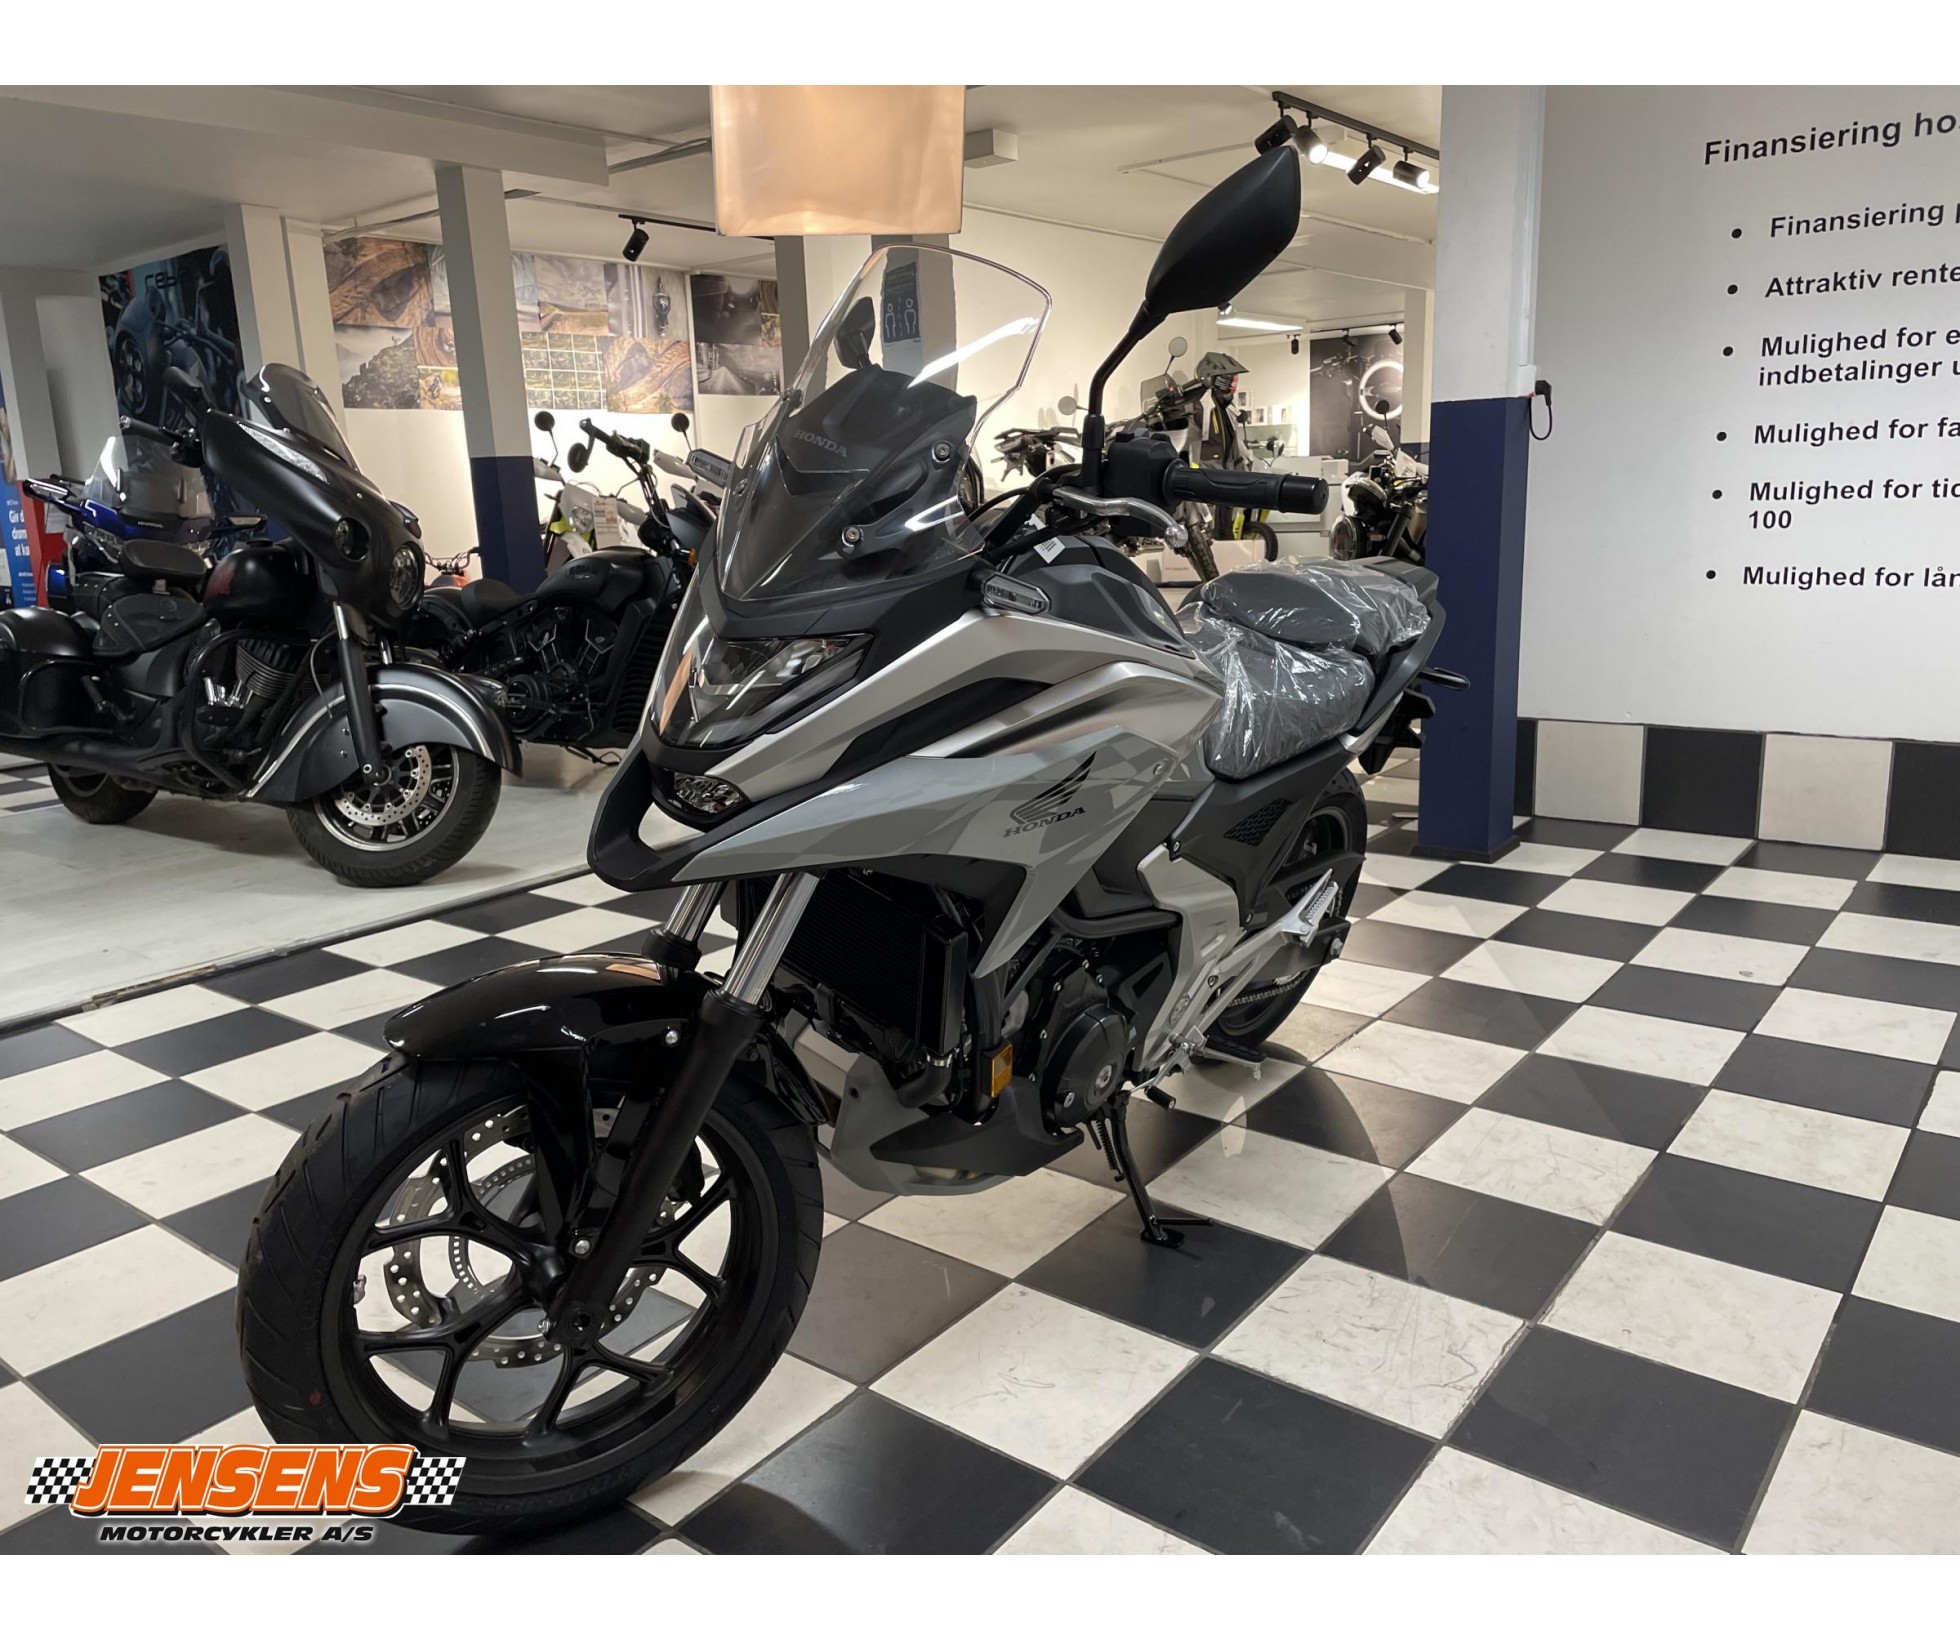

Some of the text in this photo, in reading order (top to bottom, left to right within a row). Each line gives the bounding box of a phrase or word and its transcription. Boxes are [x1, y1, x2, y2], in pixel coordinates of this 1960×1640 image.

[1704, 112, 1960, 166] Finansiering ho
[1770, 202, 1945, 239] Finansiering
[1764, 267, 1884, 299] Attraktiv
[1761, 328, 1887, 359] Mulighed
[1896, 326, 1938, 349] for
[1759, 359, 1943, 387] indbetalinger
[793, 429, 847, 459] HONDA
[1754, 419, 1880, 448] Mulighed
[1888, 418, 1930, 440] for
[1749, 478, 1875, 506] Mulighed
[1882, 478, 1924, 500] for
[1748, 509, 1793, 530] 100
[1743, 564, 1960, 591] Mulighed for lån
[1003, 806, 1086, 838] HONDA
